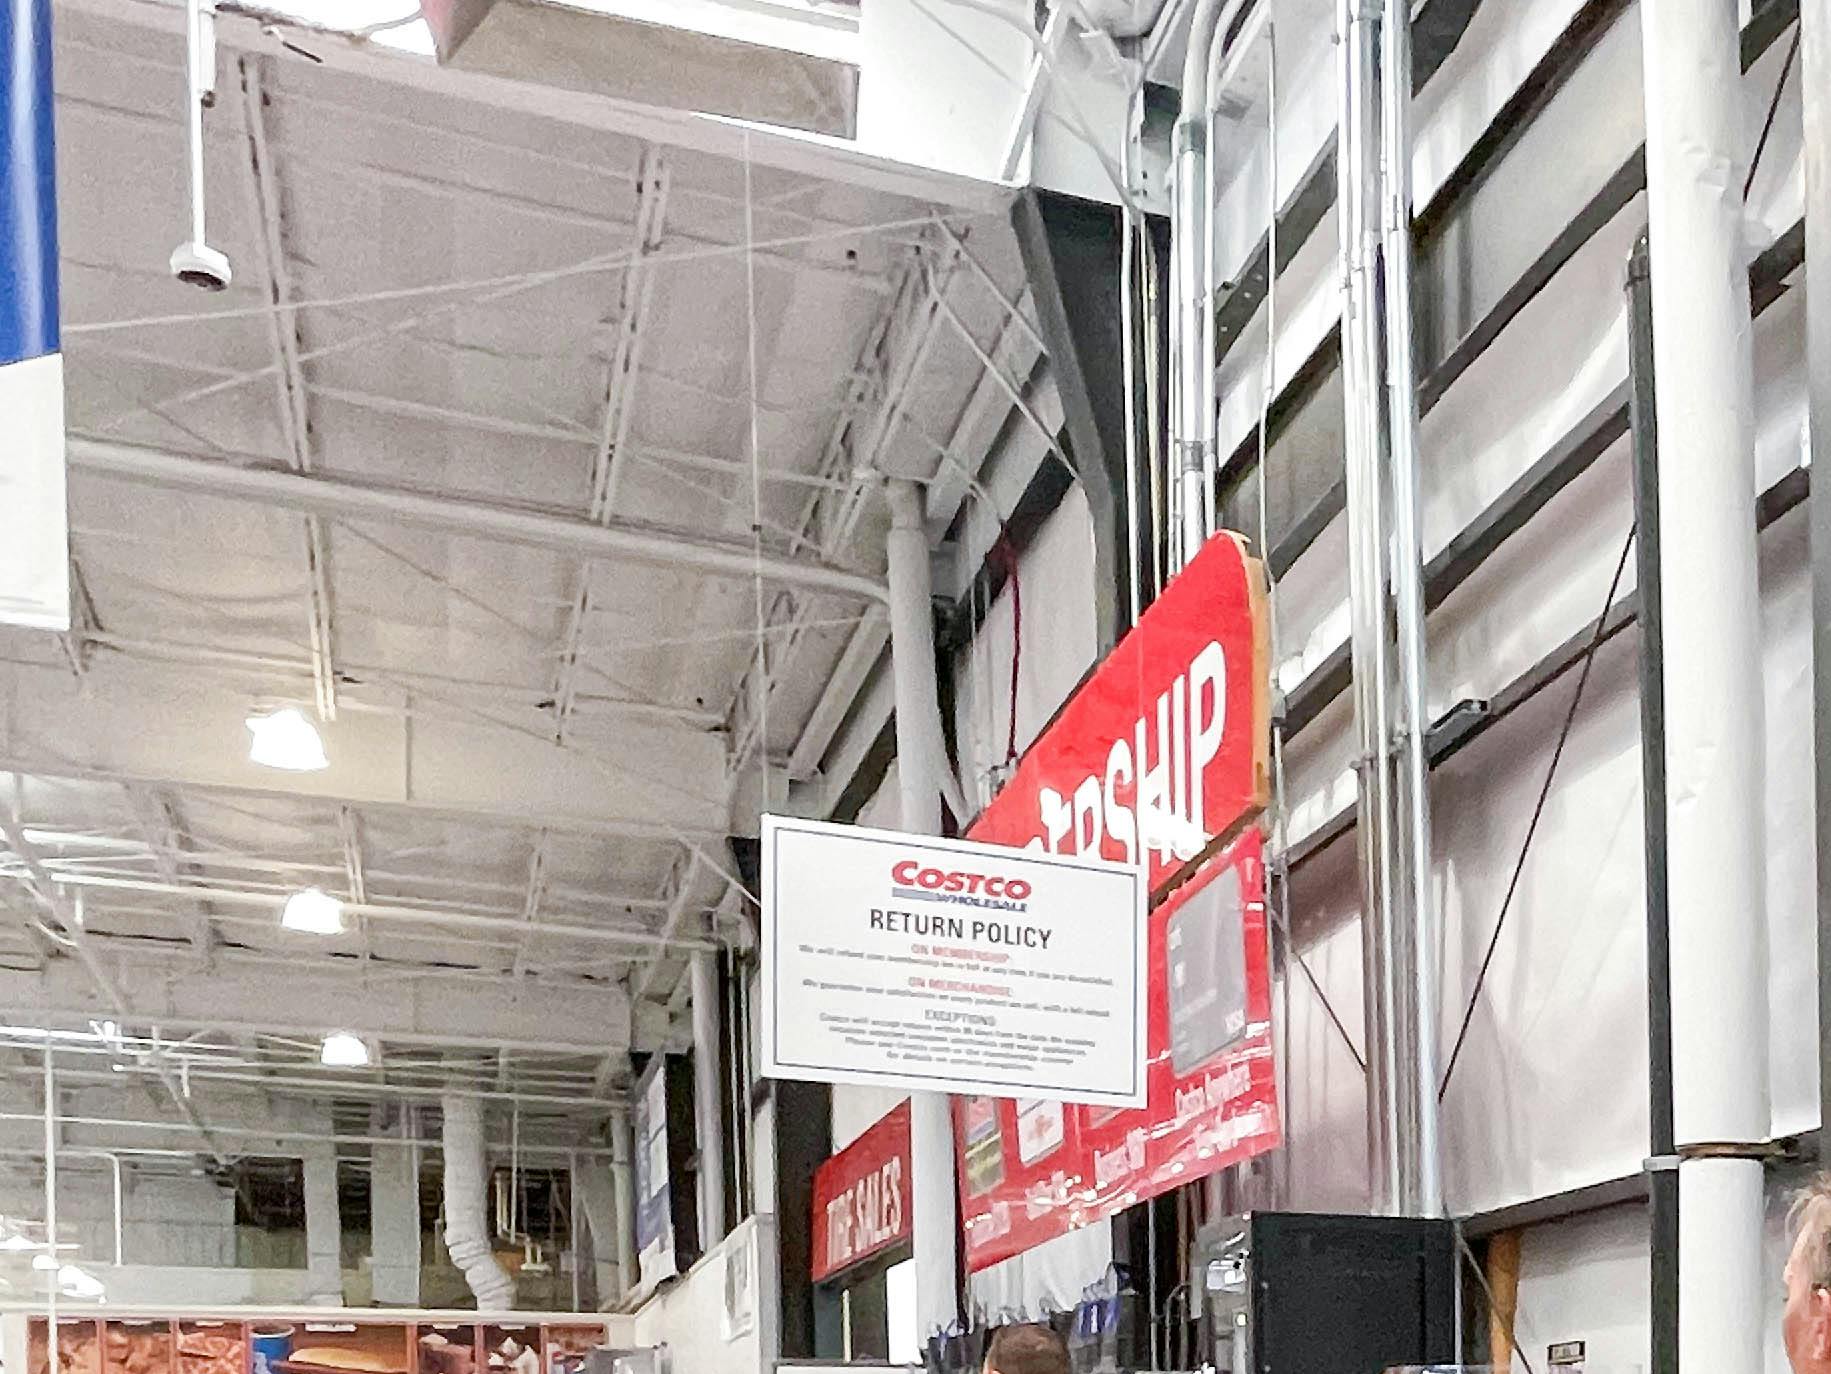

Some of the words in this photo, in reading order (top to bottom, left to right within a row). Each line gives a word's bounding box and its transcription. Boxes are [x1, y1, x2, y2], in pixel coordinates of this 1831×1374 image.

[892, 860, 1031, 899] COSTCO
[937, 892, 1027, 912] WHOLESALE
[871, 909, 963, 939] RETURN
[972, 921, 1052, 949] POLICY
